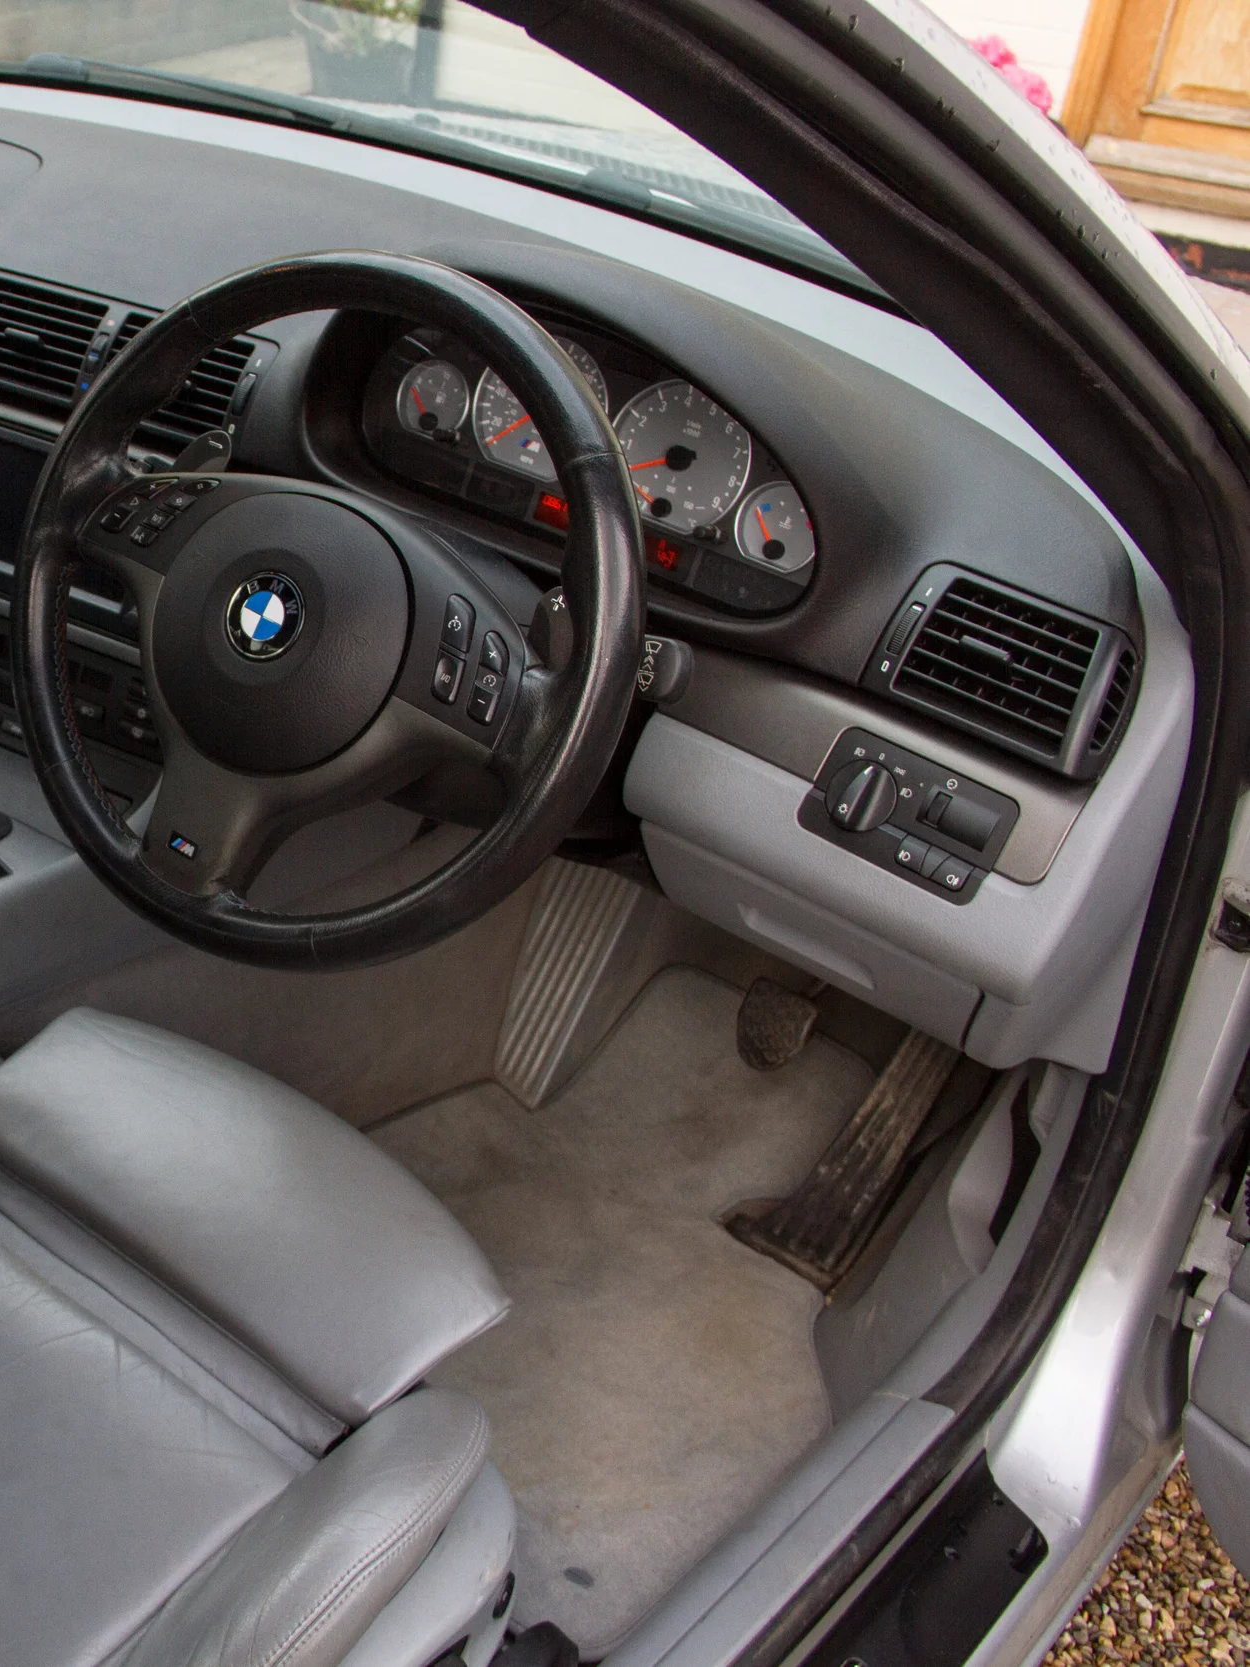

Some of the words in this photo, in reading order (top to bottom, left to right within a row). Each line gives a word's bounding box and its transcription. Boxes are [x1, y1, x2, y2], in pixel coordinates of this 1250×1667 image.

[658, 401, 667, 413] 3
[709, 403, 717, 416] 5
[638, 416, 647, 427] 2
[725, 422, 734, 433] 6
[626, 439, 633, 450] 1
[733, 447, 741, 459] 7
[728, 475, 737, 488] 8
[711, 496, 721, 509] 9
[247, 579, 298, 615] BMW
